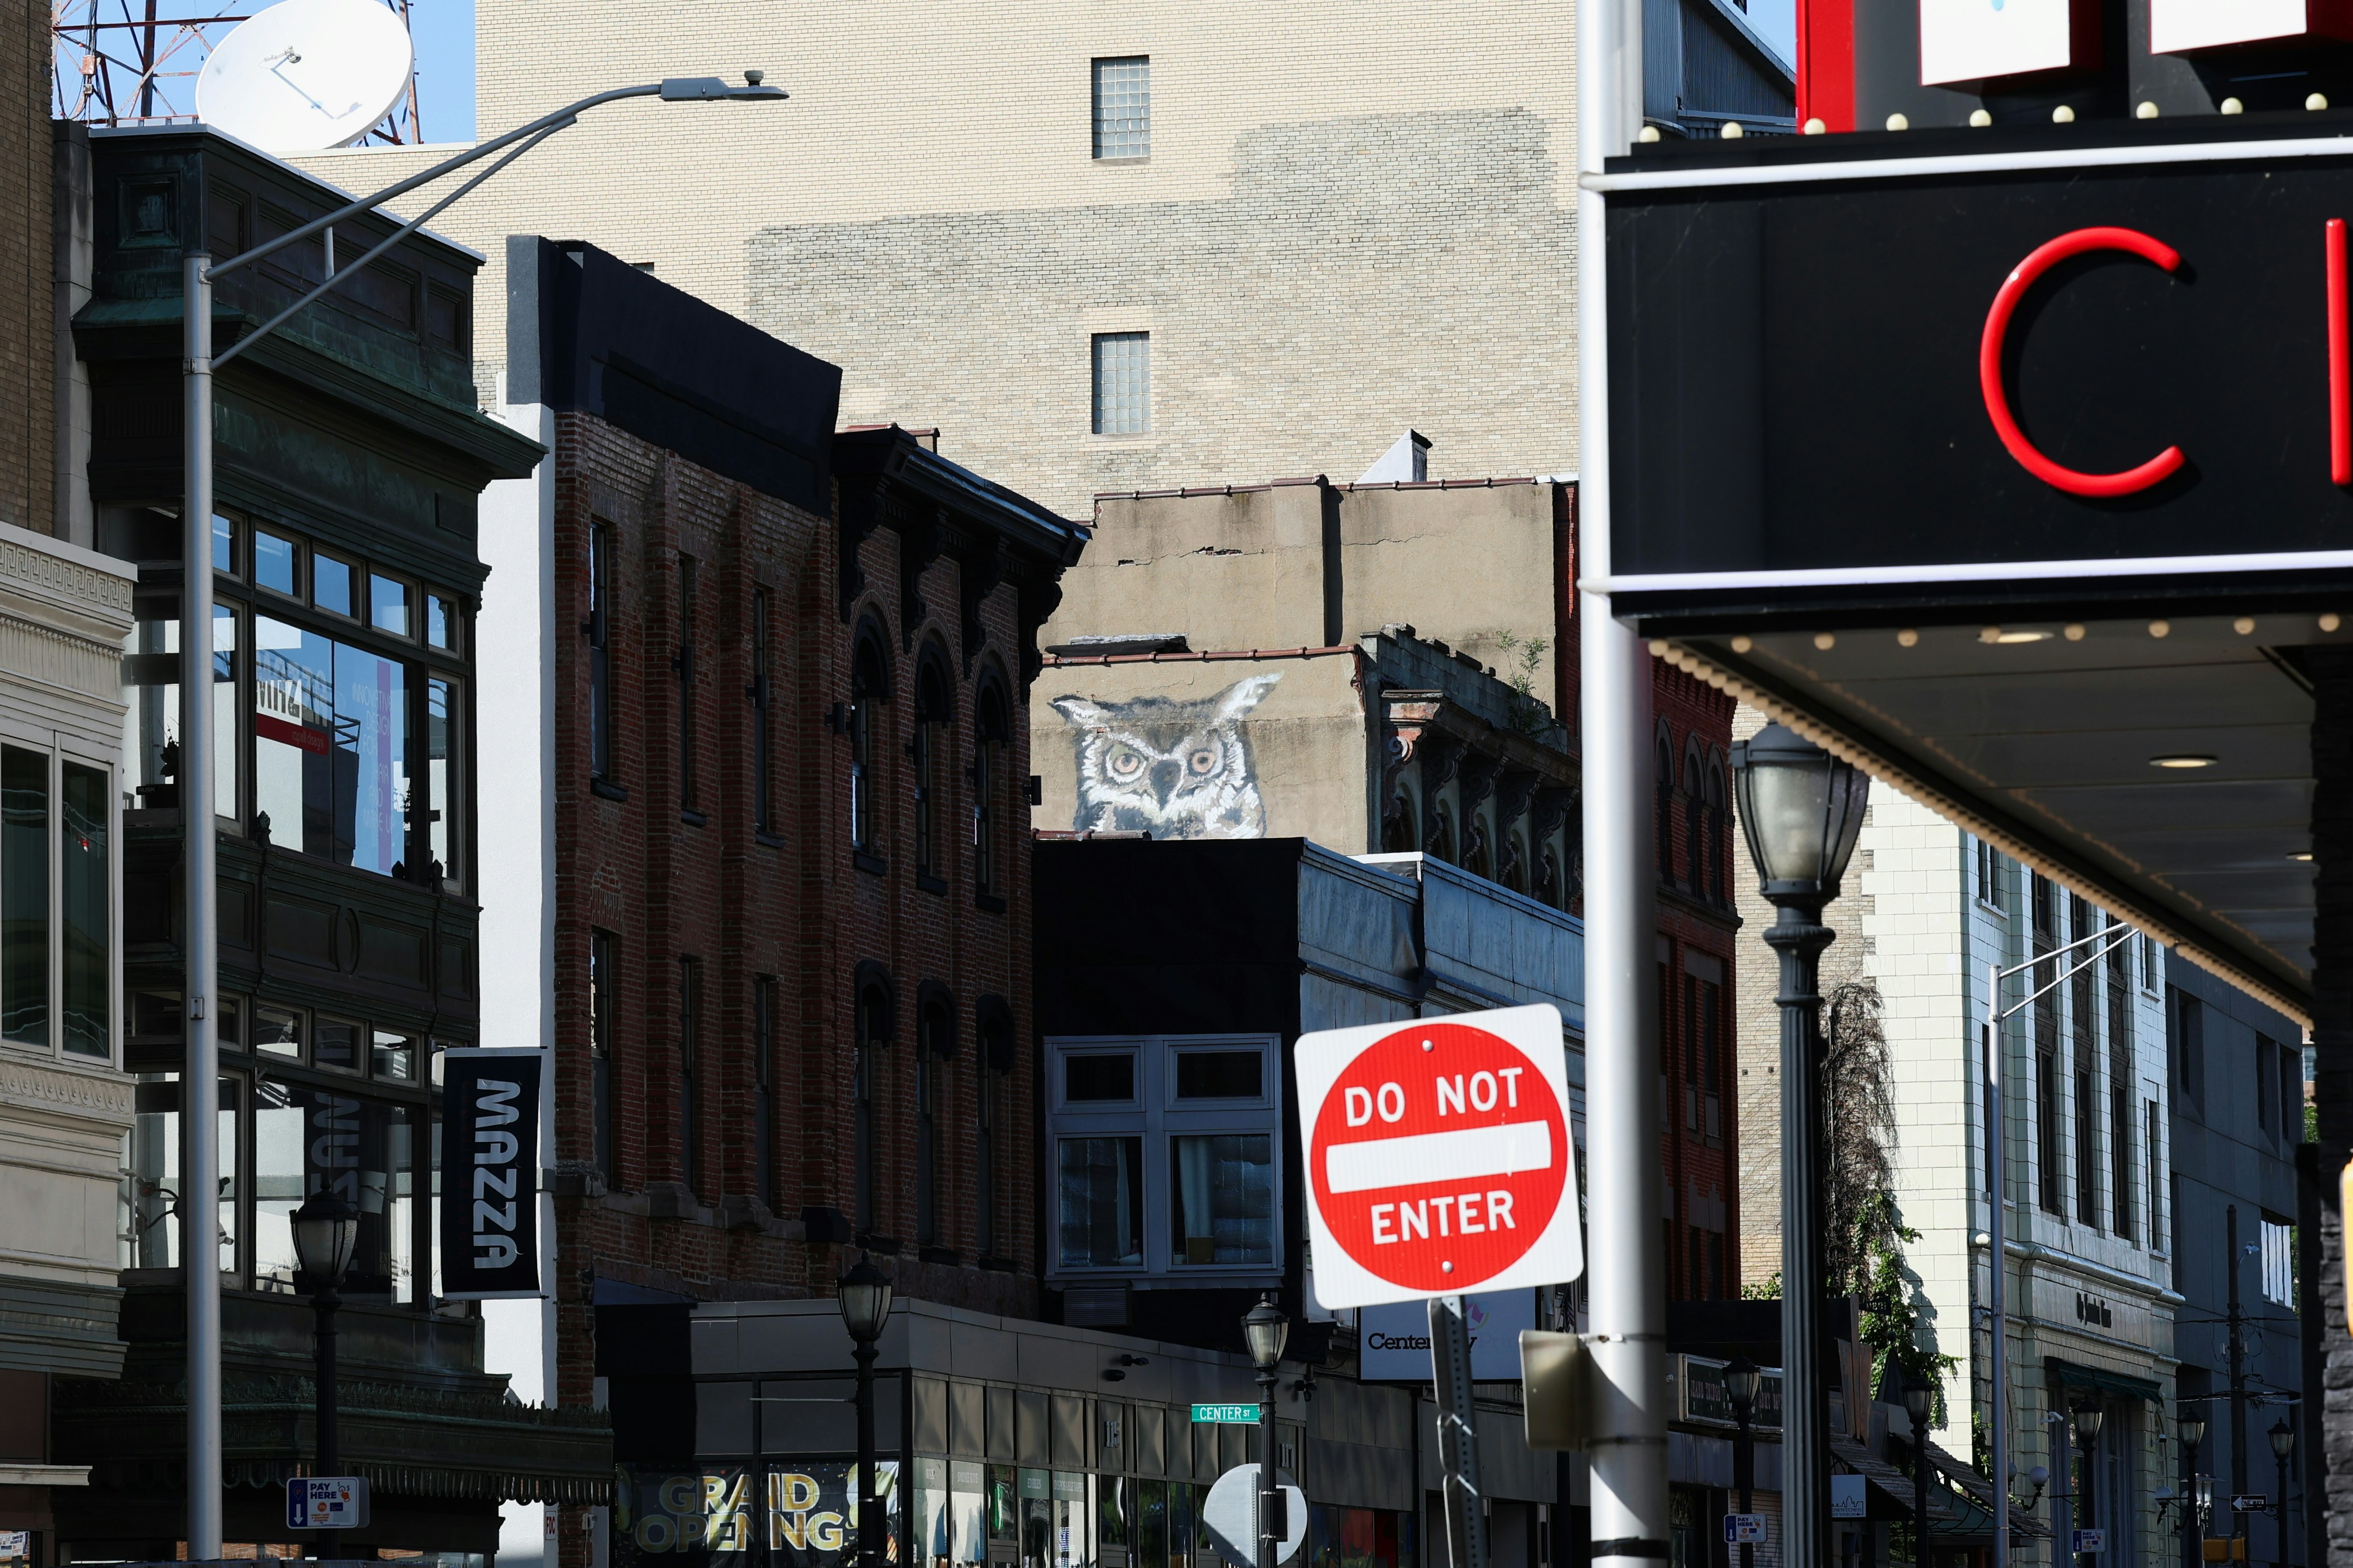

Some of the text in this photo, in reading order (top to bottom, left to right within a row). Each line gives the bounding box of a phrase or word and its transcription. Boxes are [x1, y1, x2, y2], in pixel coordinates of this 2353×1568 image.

[367, 710, 391, 737] DESIGN
[1344, 1067, 1523, 1127] DO NOT
[473, 1078, 521, 1269] MAZZA
[1371, 1190, 1515, 1245] ENTER
[380, 1252, 409, 1266] ENTNCE
[1200, 1406, 1250, 1420] CENTER ST
[1027, 1478, 1041, 1489] EDIBLES
[546, 1516, 555, 1534] FDC
[635, 1511, 844, 1553] OPENNG
